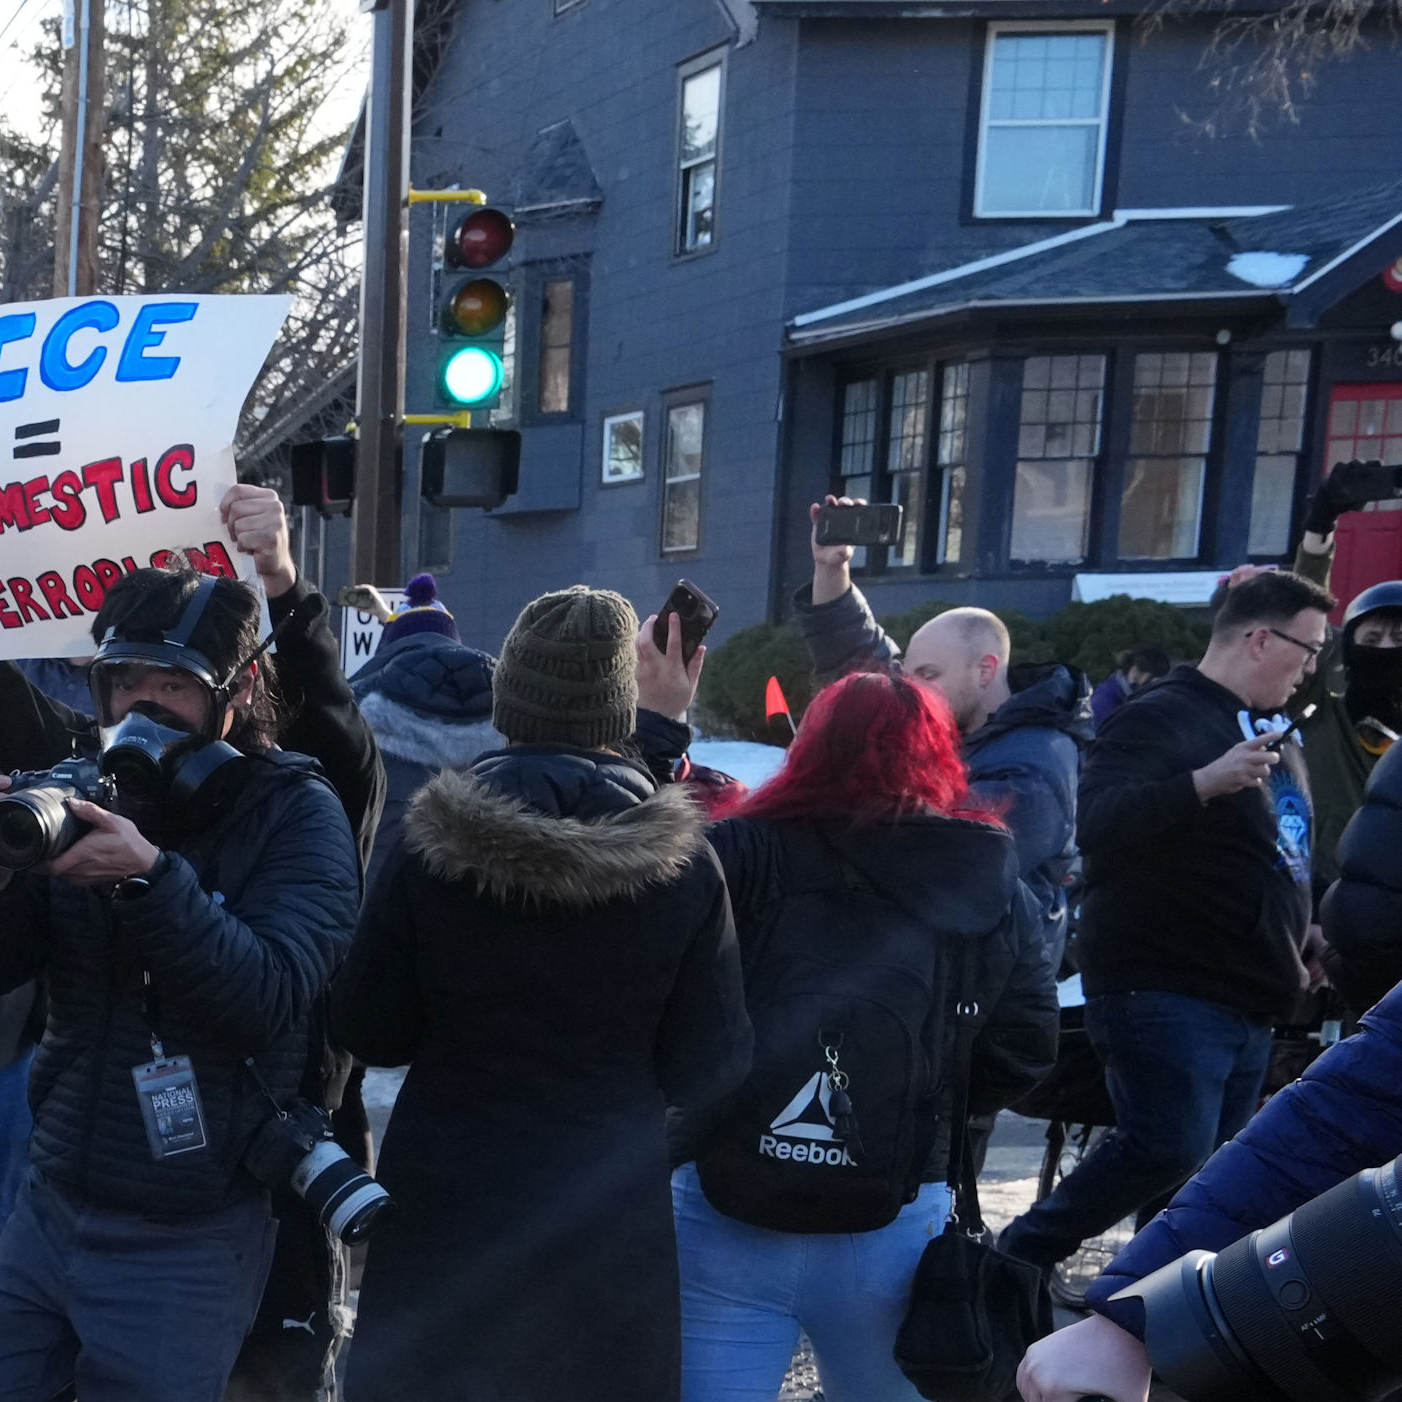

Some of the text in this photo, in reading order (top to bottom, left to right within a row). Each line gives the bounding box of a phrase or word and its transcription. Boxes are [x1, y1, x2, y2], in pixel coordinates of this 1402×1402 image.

[13, 418, 62, 460] =
[51, 772, 73, 780] Canon
[151, 1086, 192, 1101] NATIONAL
[153, 1093, 194, 1110] PRESS
[1268, 1249, 1285, 1265] G
